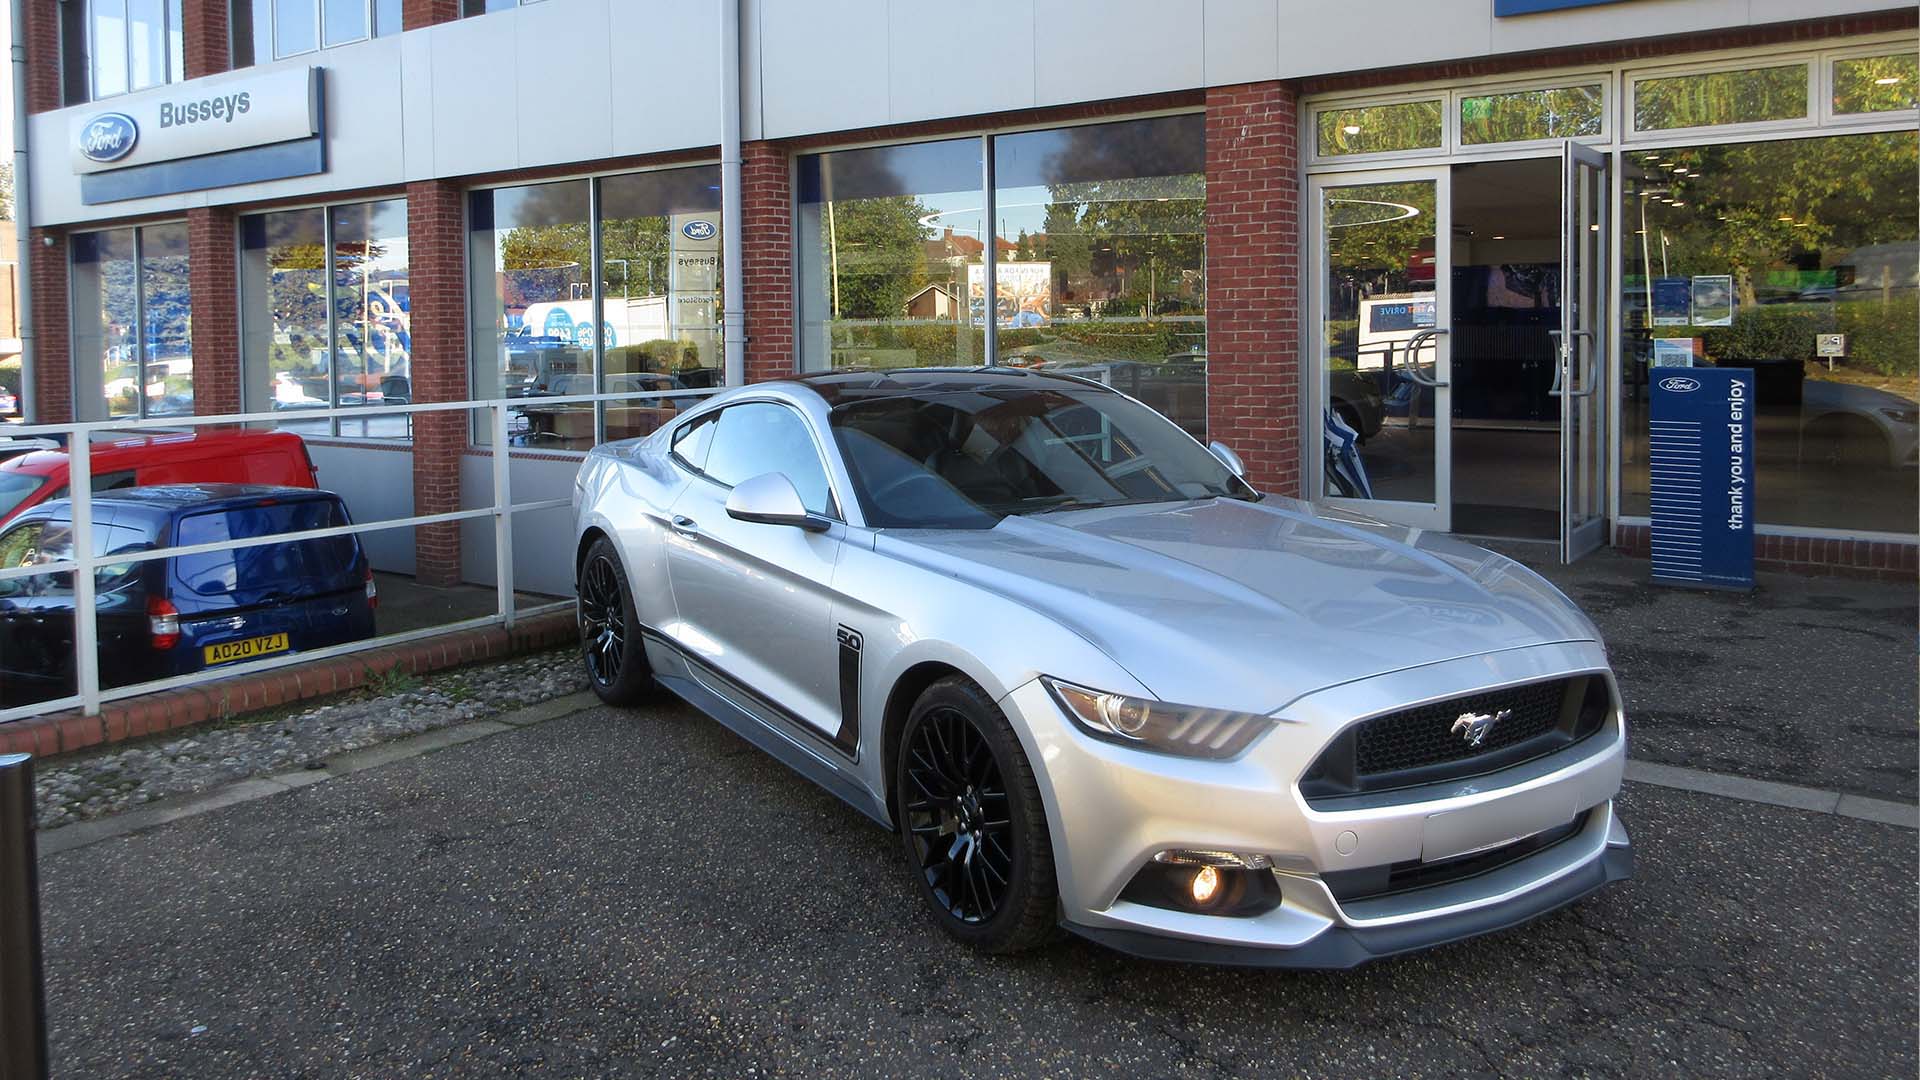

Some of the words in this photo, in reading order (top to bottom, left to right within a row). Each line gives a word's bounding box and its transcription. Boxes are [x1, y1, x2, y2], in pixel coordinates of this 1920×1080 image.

[160, 91, 250, 128] Busseys
[87, 121, 122, 151] Ford
[1665, 379, 1694, 389] Ford
[1727, 379, 1746, 421] enjoy
[1727, 423, 1743, 453] and
[1730, 456, 1746, 484] you
[1727, 486, 1743, 530] thank
[212, 642, 251, 661] AO20
[256, 635, 284, 651] VZJ
